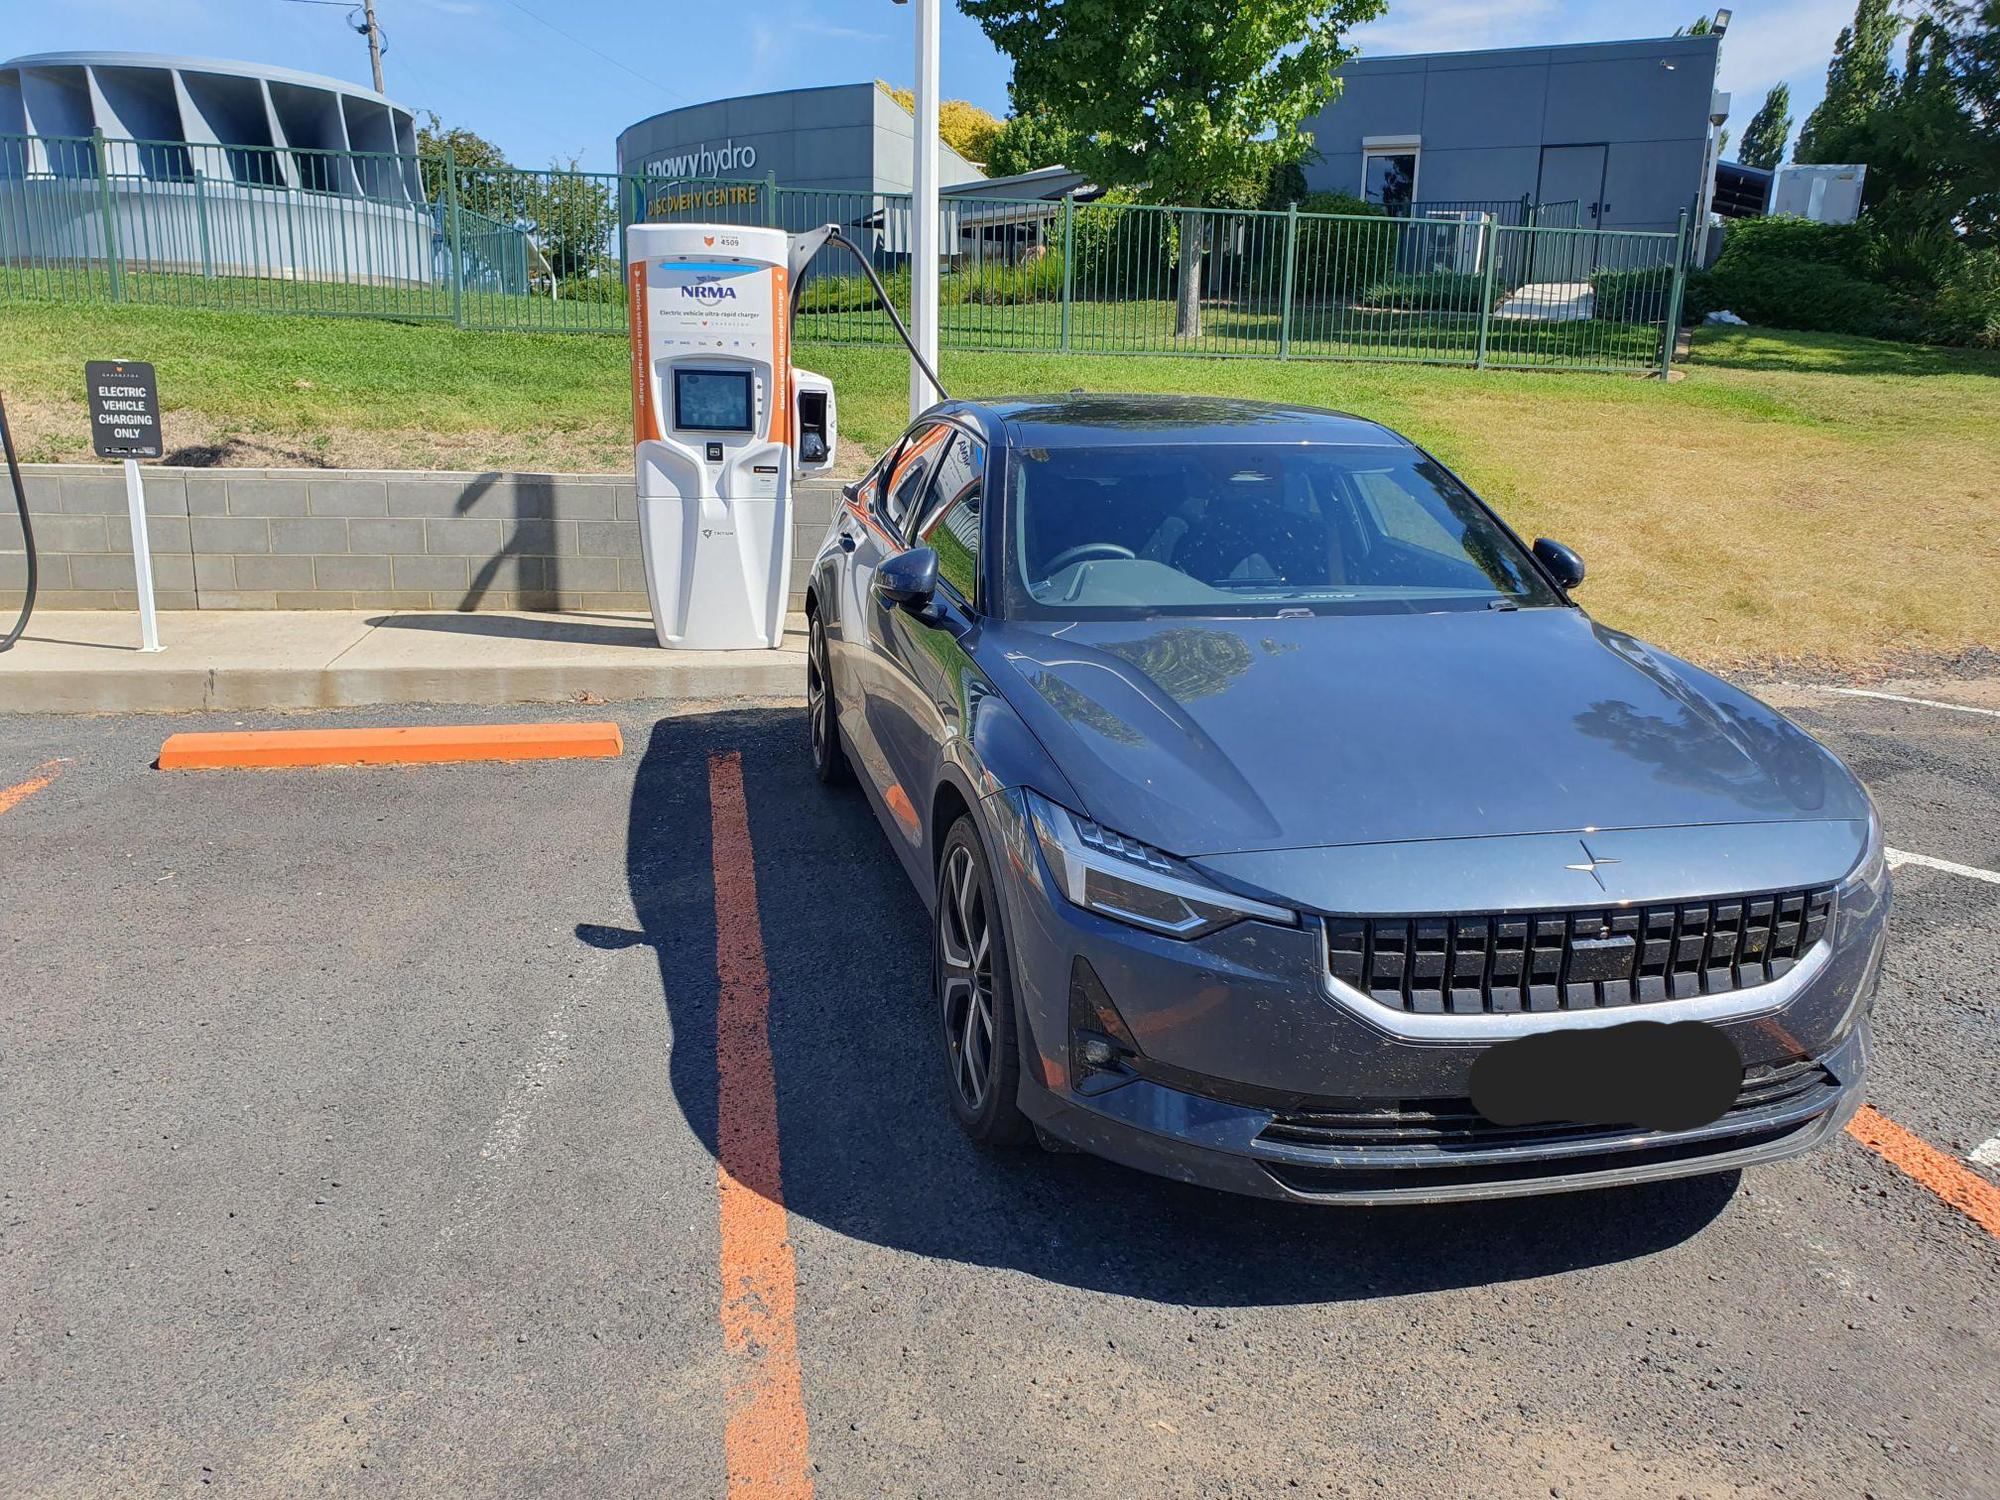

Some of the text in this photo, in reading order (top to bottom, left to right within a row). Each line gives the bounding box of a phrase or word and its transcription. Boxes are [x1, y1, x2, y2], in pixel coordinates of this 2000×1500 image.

[705, 185, 757, 207] CENTRE
[720, 239, 739, 247] 4509
[681, 286, 736, 299] NRMA
[98, 386, 147, 397] ELECTRIC
[102, 400, 145, 411] VEHICLE
[98, 414, 152, 425] CHARGING
[114, 428, 140, 439] ONLY
